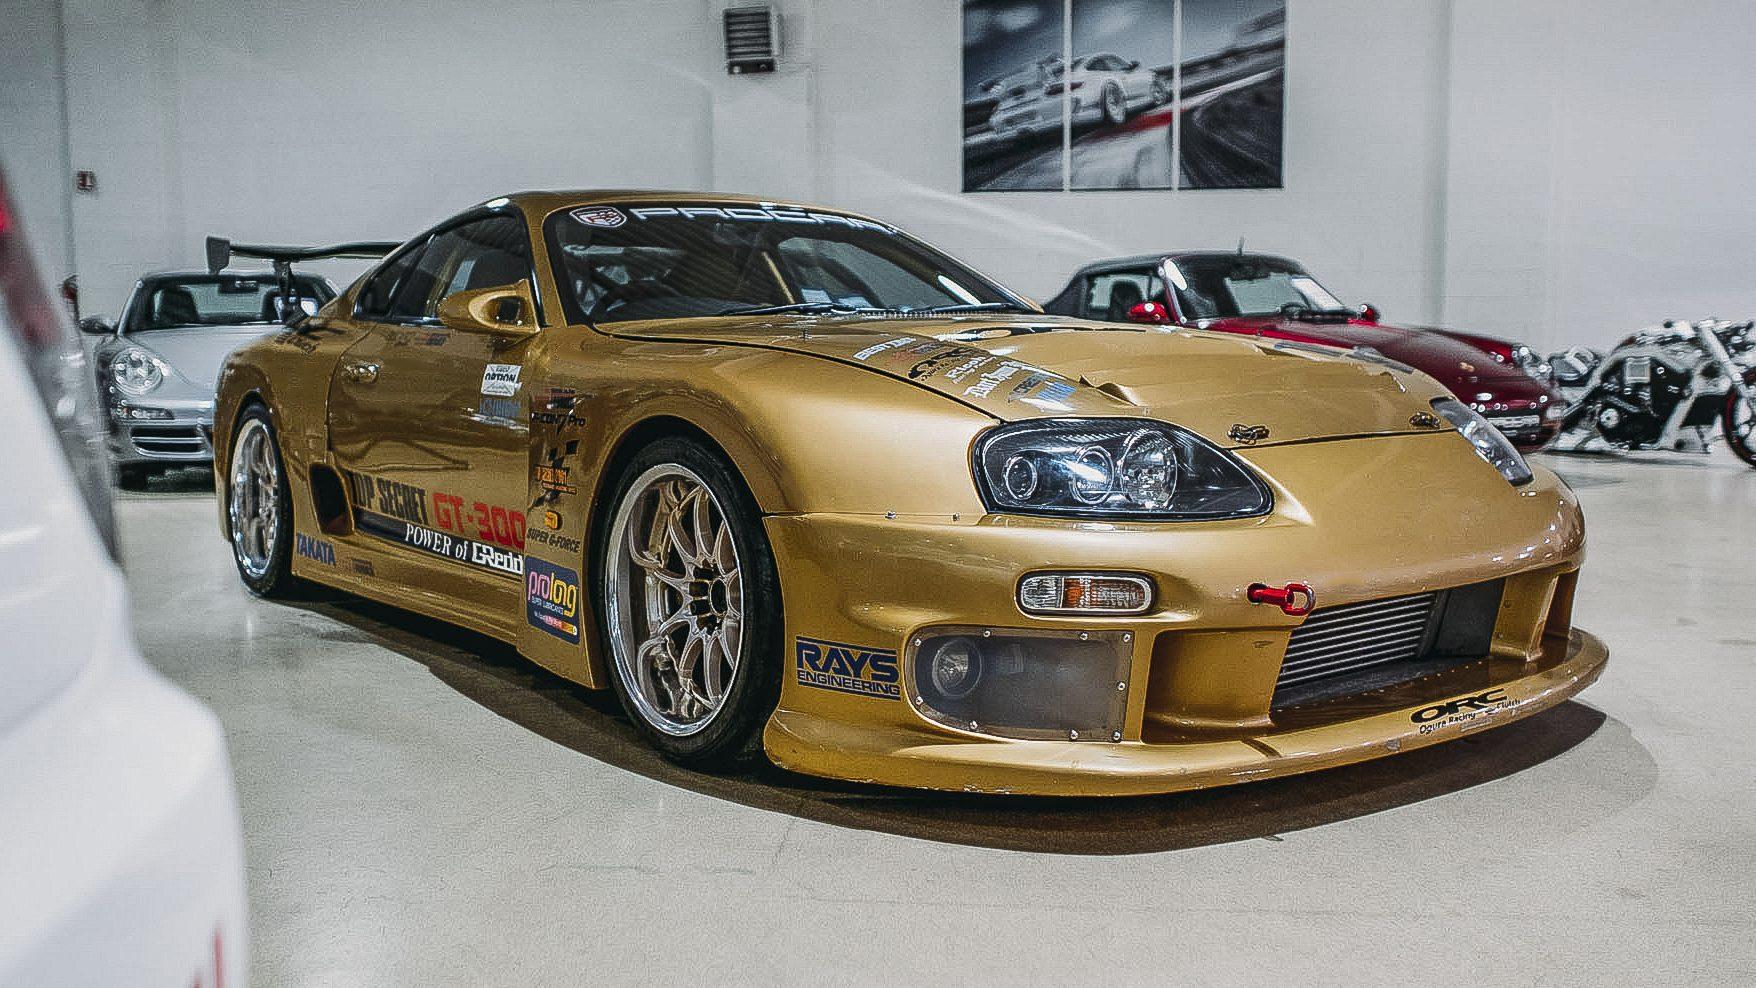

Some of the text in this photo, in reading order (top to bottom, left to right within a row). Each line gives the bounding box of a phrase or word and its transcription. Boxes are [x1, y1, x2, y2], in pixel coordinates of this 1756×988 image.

[377, 477, 429, 525] SECRET
[297, 530, 336, 565] TAKATA
[405, 523, 451, 555] POWER
[455, 540, 468, 560] of
[526, 528, 580, 552] SUPER G-FORCE
[796, 640, 900, 683] RAYS
[798, 671, 900, 695] ENGINEERING
[1410, 688, 1507, 723] ORC
[1448, 712, 1476, 725] Racing
